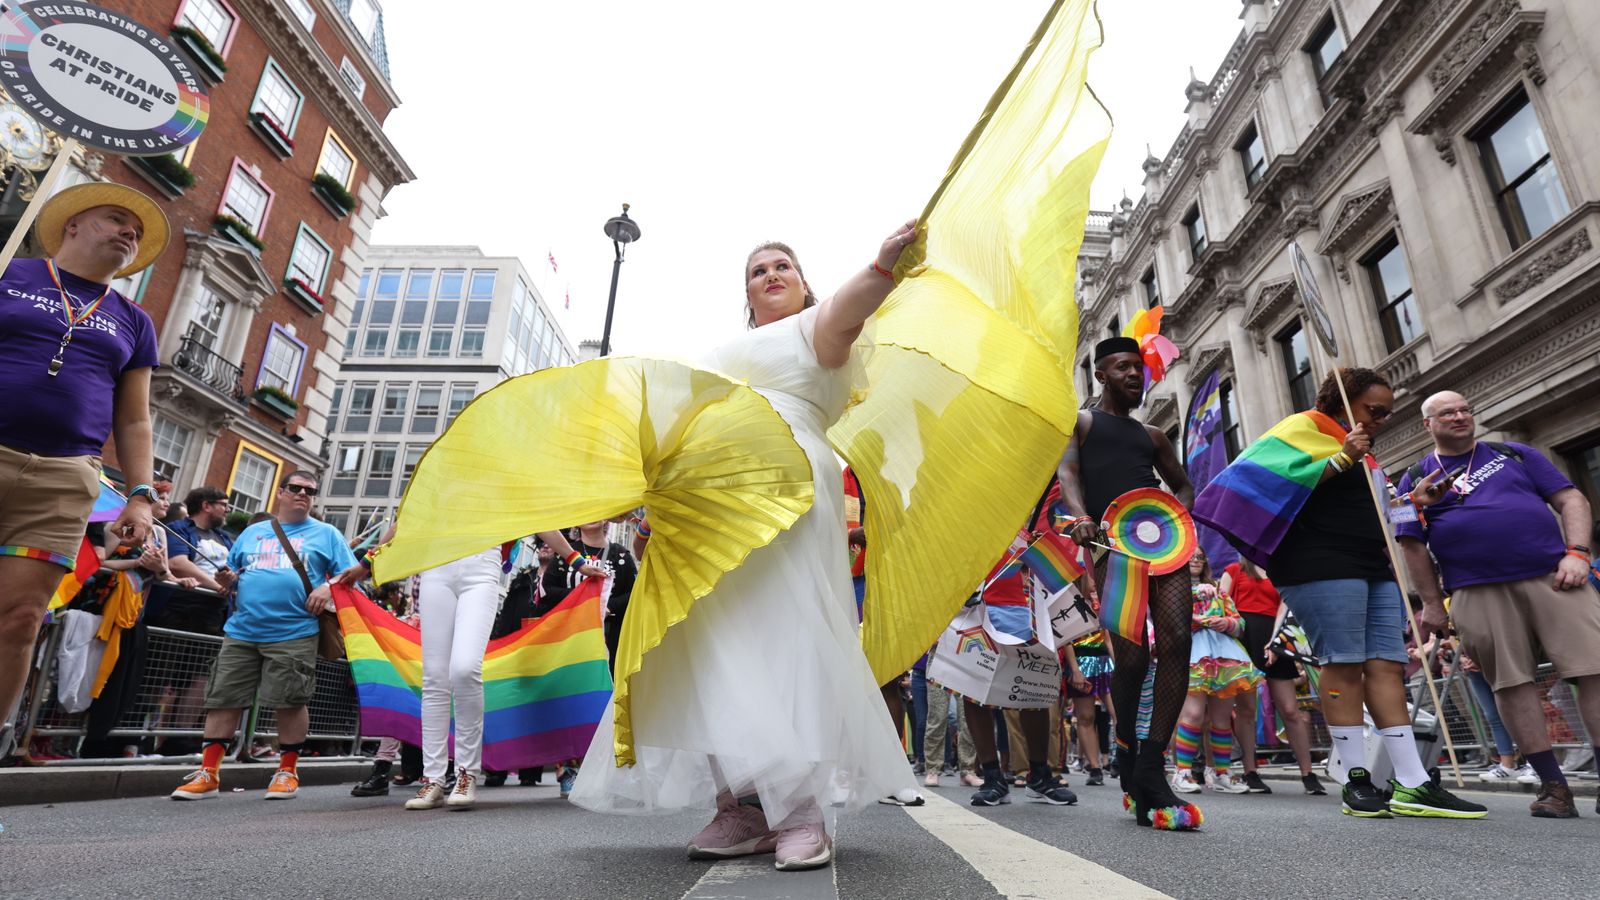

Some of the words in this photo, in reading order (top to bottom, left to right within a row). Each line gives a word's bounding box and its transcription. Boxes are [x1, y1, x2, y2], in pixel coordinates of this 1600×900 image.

[33, 4, 148, 39] CELEBRATING
[149, 37, 170, 53] 50
[168, 54, 200, 93] YEARS
[40, 33, 177, 105] CHRISTIANS
[0, 60, 19, 79] OF
[13, 83, 67, 126] PRIDE
[71, 125, 93, 139] IN
[102, 135, 138, 149] THE
[144, 135, 178, 148] U.K.
[49, 57, 83, 78] AT
[85, 72, 155, 113] PRIDE
[33, 303, 60, 314] AT
[80, 319, 117, 337] RIDE
[1478, 463, 1505, 482] PROUD
[980, 652, 996, 662] HOUSE
